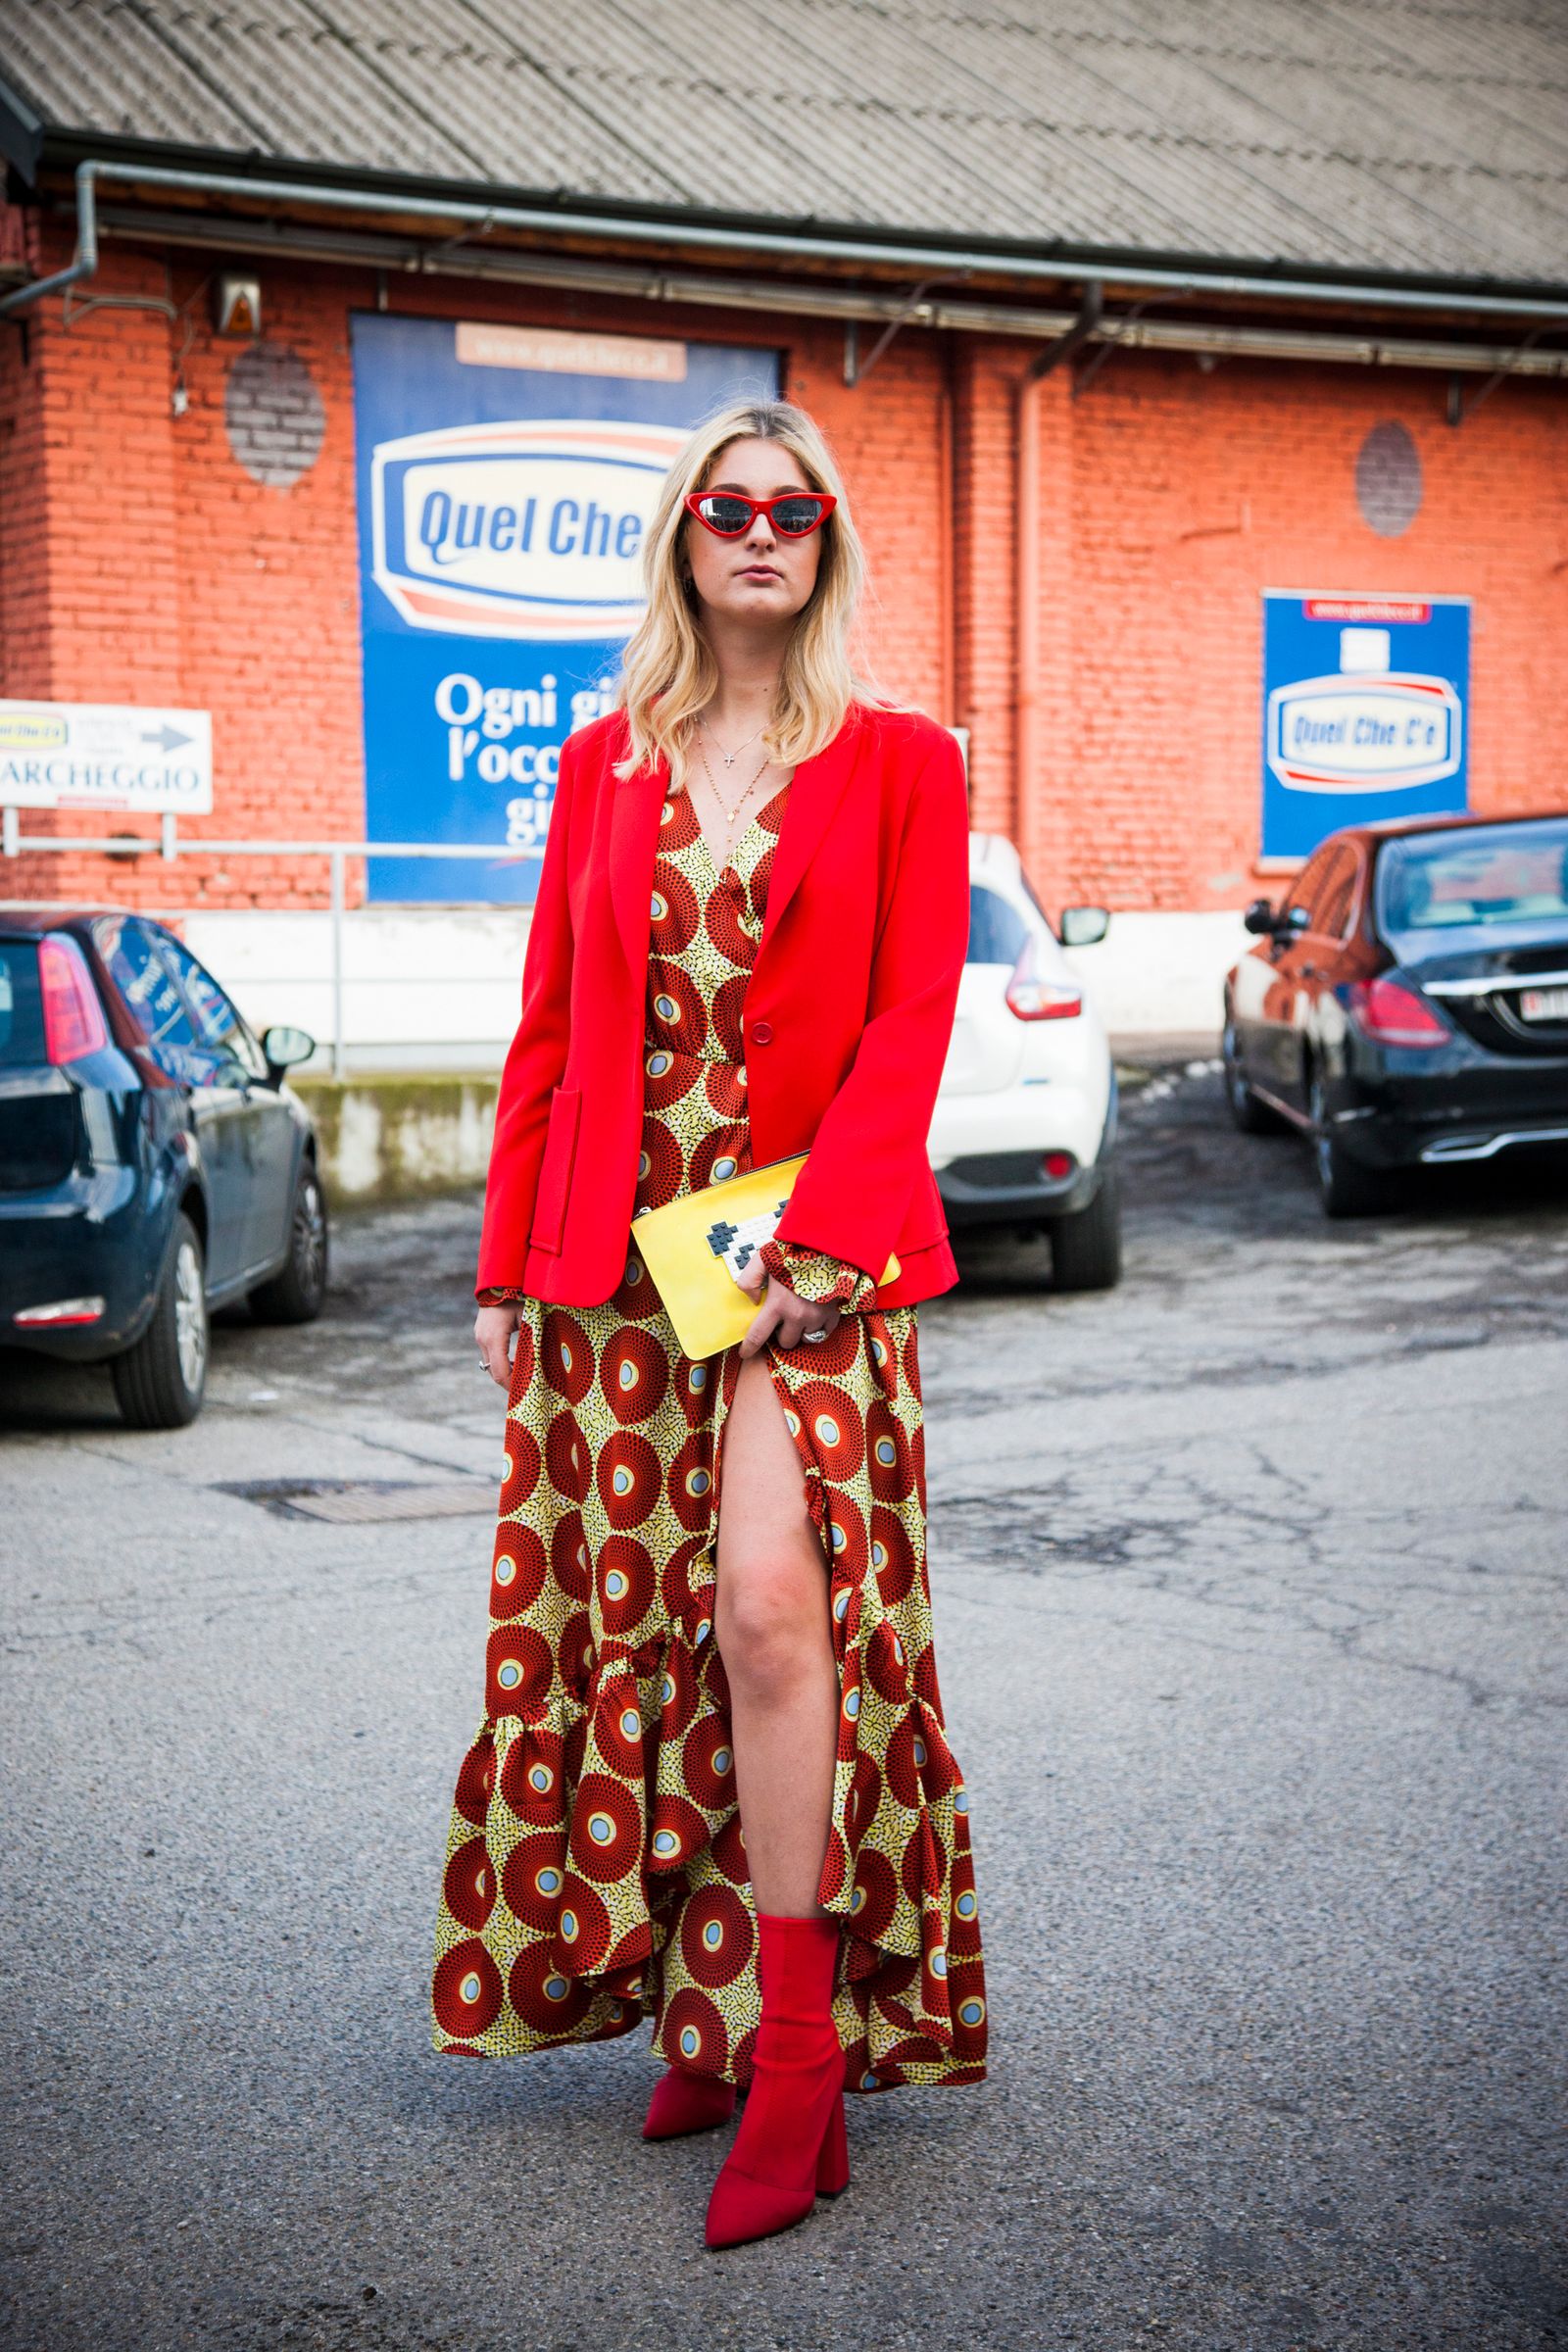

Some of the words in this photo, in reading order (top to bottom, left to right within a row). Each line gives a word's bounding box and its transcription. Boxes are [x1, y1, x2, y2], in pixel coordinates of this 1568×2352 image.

[419, 490, 537, 564] Quel
[548, 499, 643, 559] Che
[434, 672, 558, 740] Ogni
[570, 676, 615, 735] gi
[0, 760, 200, 791] ARCHEGGIO
[448, 726, 562, 784] l'occ
[506, 783, 554, 846] gi
